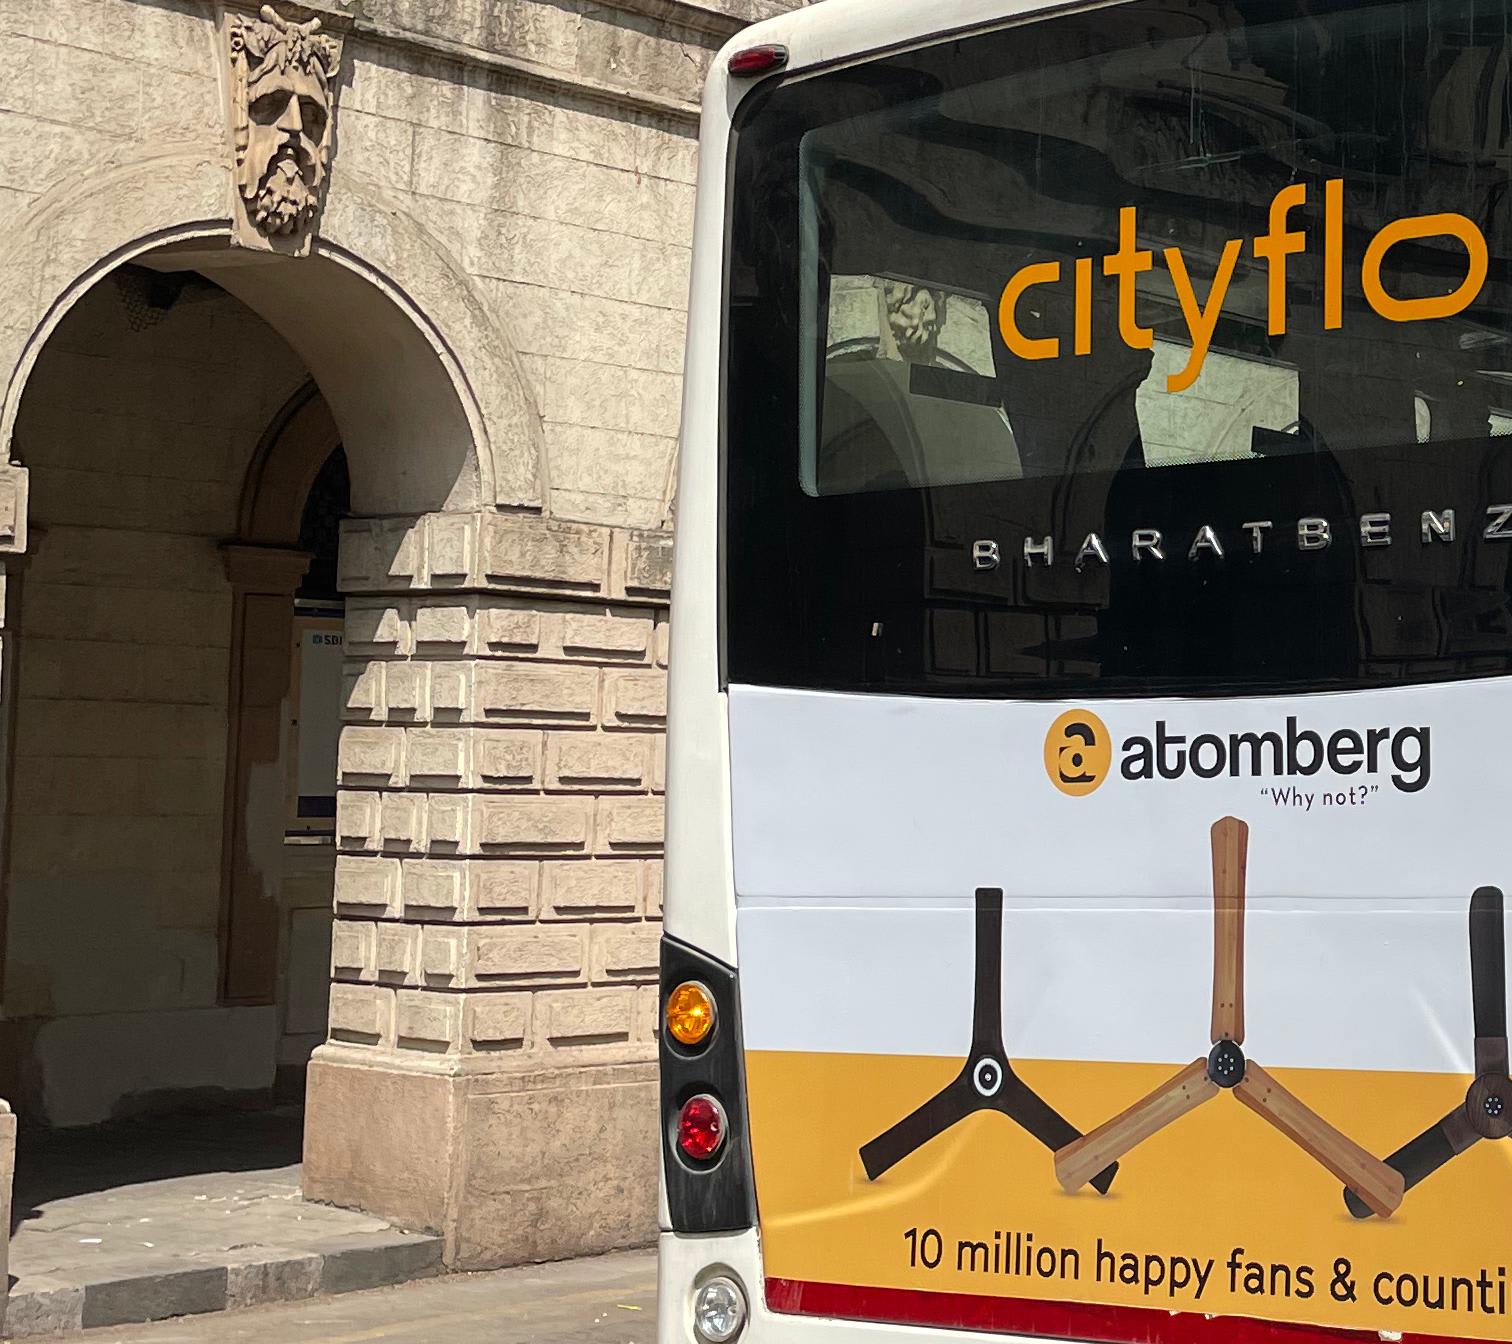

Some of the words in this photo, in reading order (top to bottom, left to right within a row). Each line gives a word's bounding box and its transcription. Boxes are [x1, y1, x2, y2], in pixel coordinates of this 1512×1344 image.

[999, 179, 1488, 393] cityflo
[1120, 716, 1431, 793] atomberg
[903, 1227, 943, 1270] 10
[956, 1230, 1080, 1282] million
[1095, 1238, 1214, 1299] happy
[1226, 1247, 1314, 1299] fans
[1329, 1257, 1358, 1303] &
